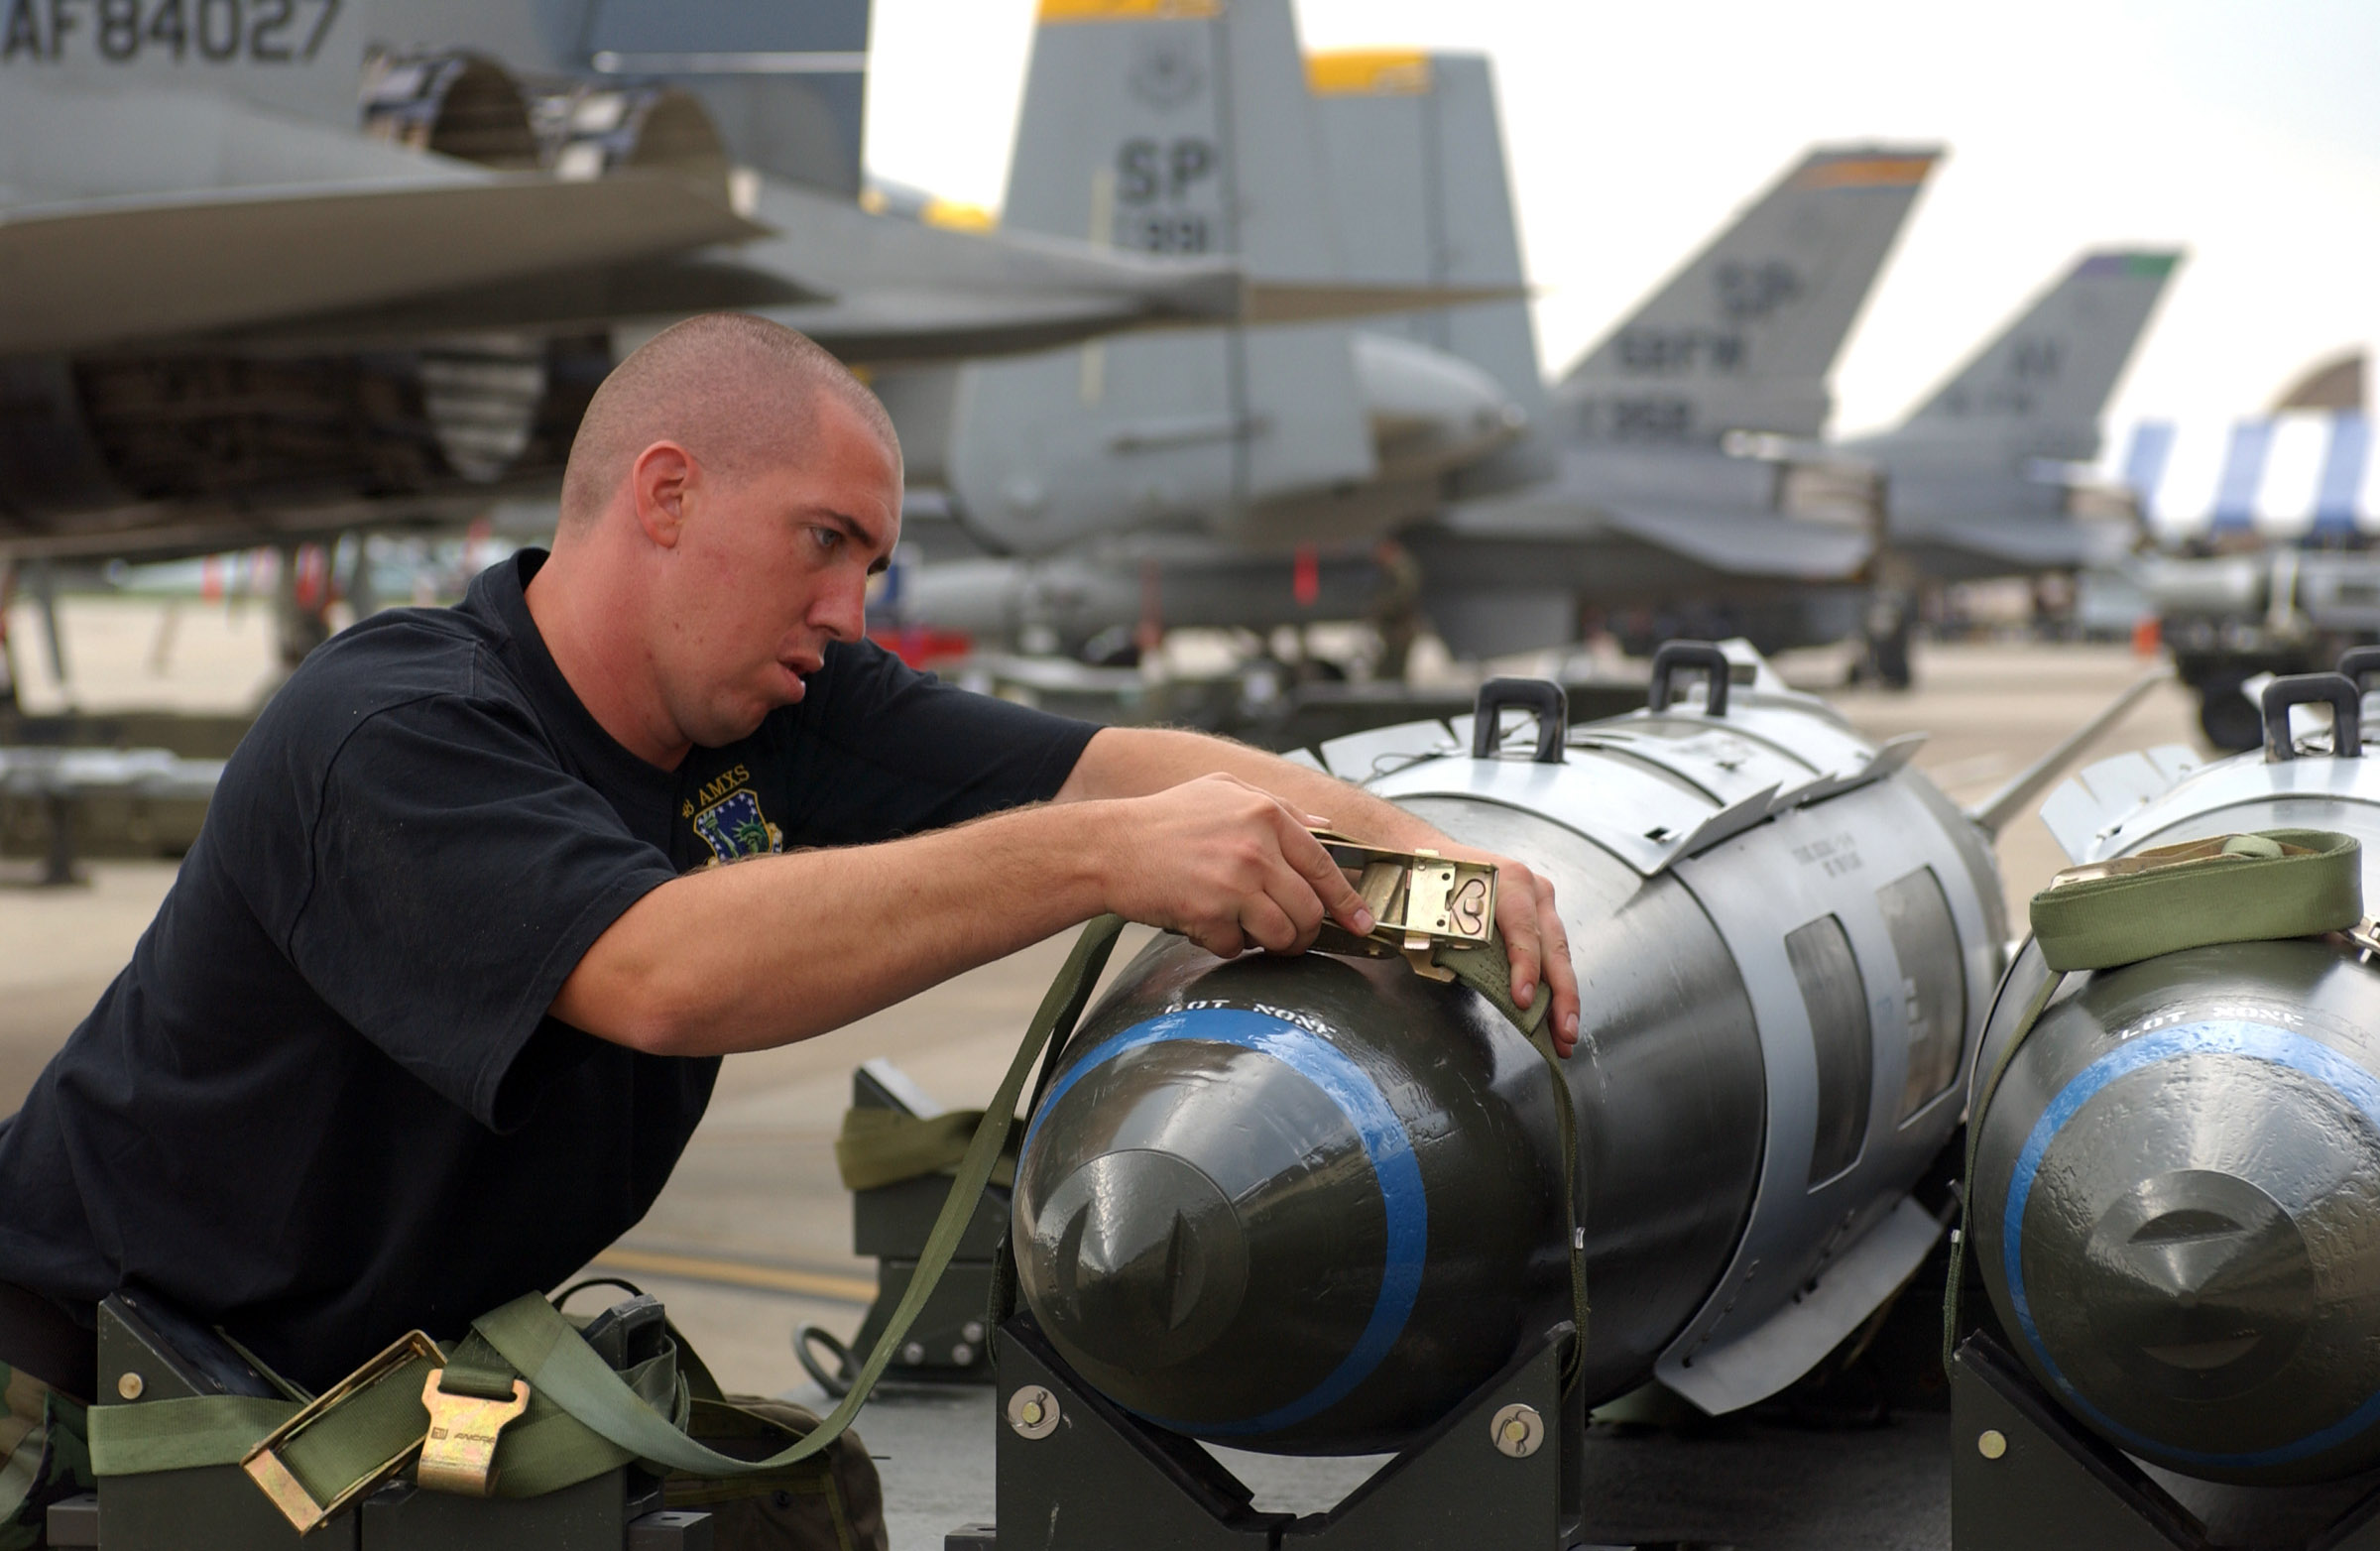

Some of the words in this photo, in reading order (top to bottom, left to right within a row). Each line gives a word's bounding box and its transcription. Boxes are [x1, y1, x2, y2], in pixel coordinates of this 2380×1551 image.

[1117, 137, 1216, 204] SP
[698, 763, 750, 806] AMXS
[2121, 1011, 2187, 1039] LOT
